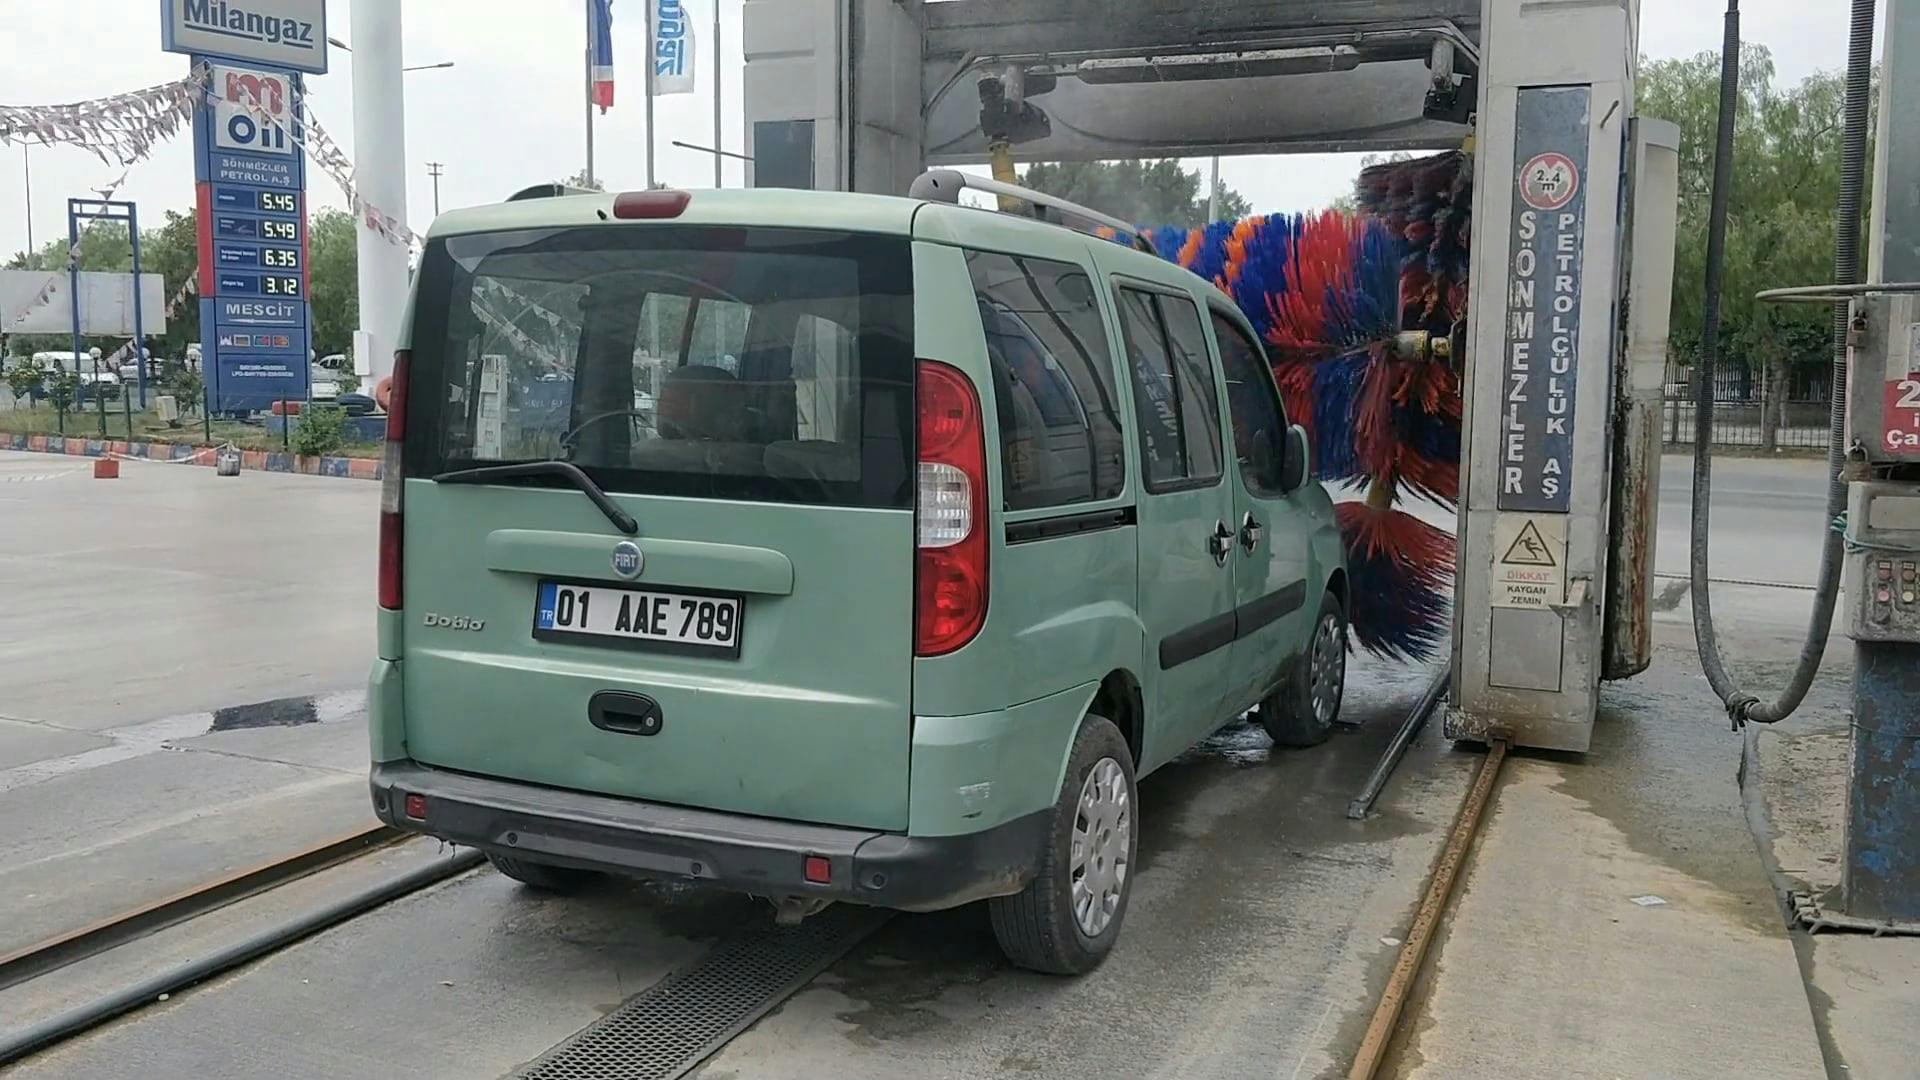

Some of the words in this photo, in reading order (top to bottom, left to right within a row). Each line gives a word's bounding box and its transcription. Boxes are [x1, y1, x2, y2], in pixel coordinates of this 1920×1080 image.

[184, 0, 313, 43] Milangaz
[228, 114, 284, 148] Oil
[220, 170, 268, 183] PETROL
[1536, 170, 1561, 183] 2.4
[1542, 182, 1556, 191] m
[263, 192, 294, 212] 5.45
[263, 220, 296, 240] 5.49
[265, 248, 297, 268] 6.35
[266, 276, 298, 295] 3.12
[1545, 213, 1576, 435] PETROLÇÜLÜK
[1505, 211, 1537, 494] SÖNMEZLER
[1540, 457, 1562, 499] AŞ
[614, 551, 638, 569] FIAT
[1507, 585, 1547, 595] KAYGAN
[541, 609, 553, 621] TR
[556, 588, 590, 628] 01
[614, 594, 670, 636] AAE
[678, 599, 735, 642] 789
